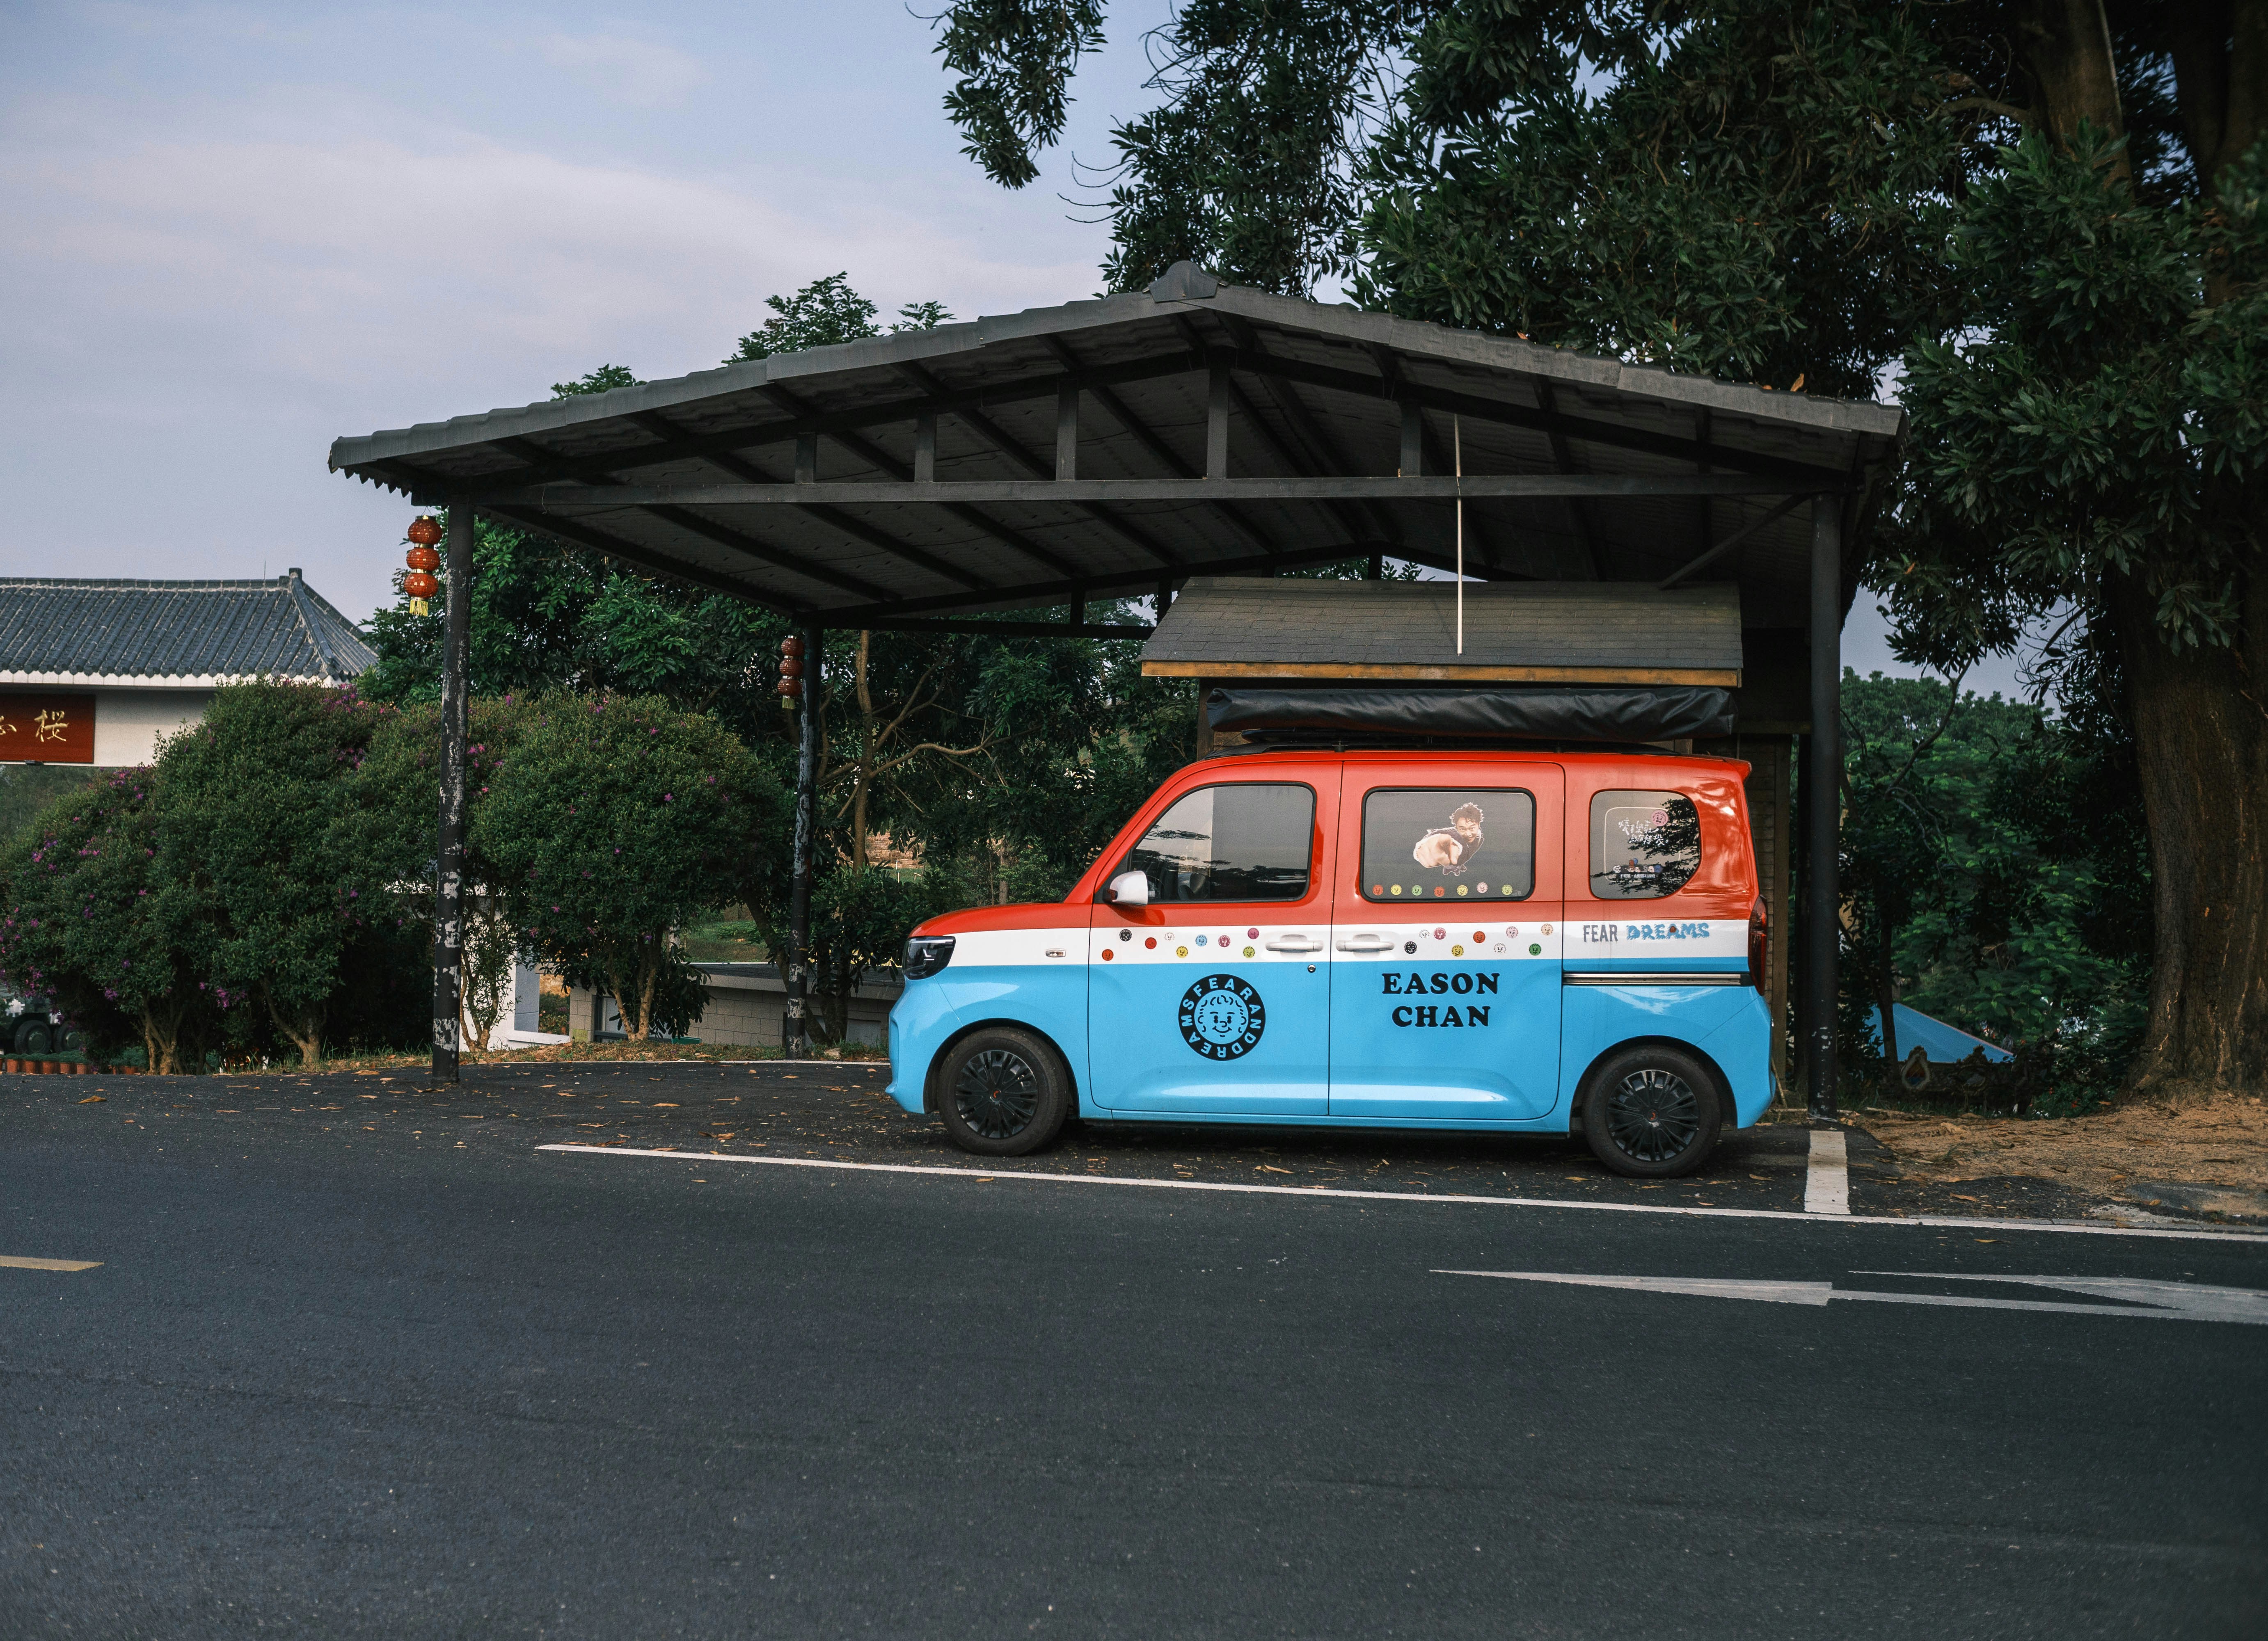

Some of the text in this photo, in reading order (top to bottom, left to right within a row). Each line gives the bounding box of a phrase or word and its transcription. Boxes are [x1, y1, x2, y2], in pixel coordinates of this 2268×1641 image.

[1583, 922, 1710, 942] FEAR DREAMS
[1382, 973, 1500, 994] EASON
[1392, 1006, 1491, 1027] CHAN
